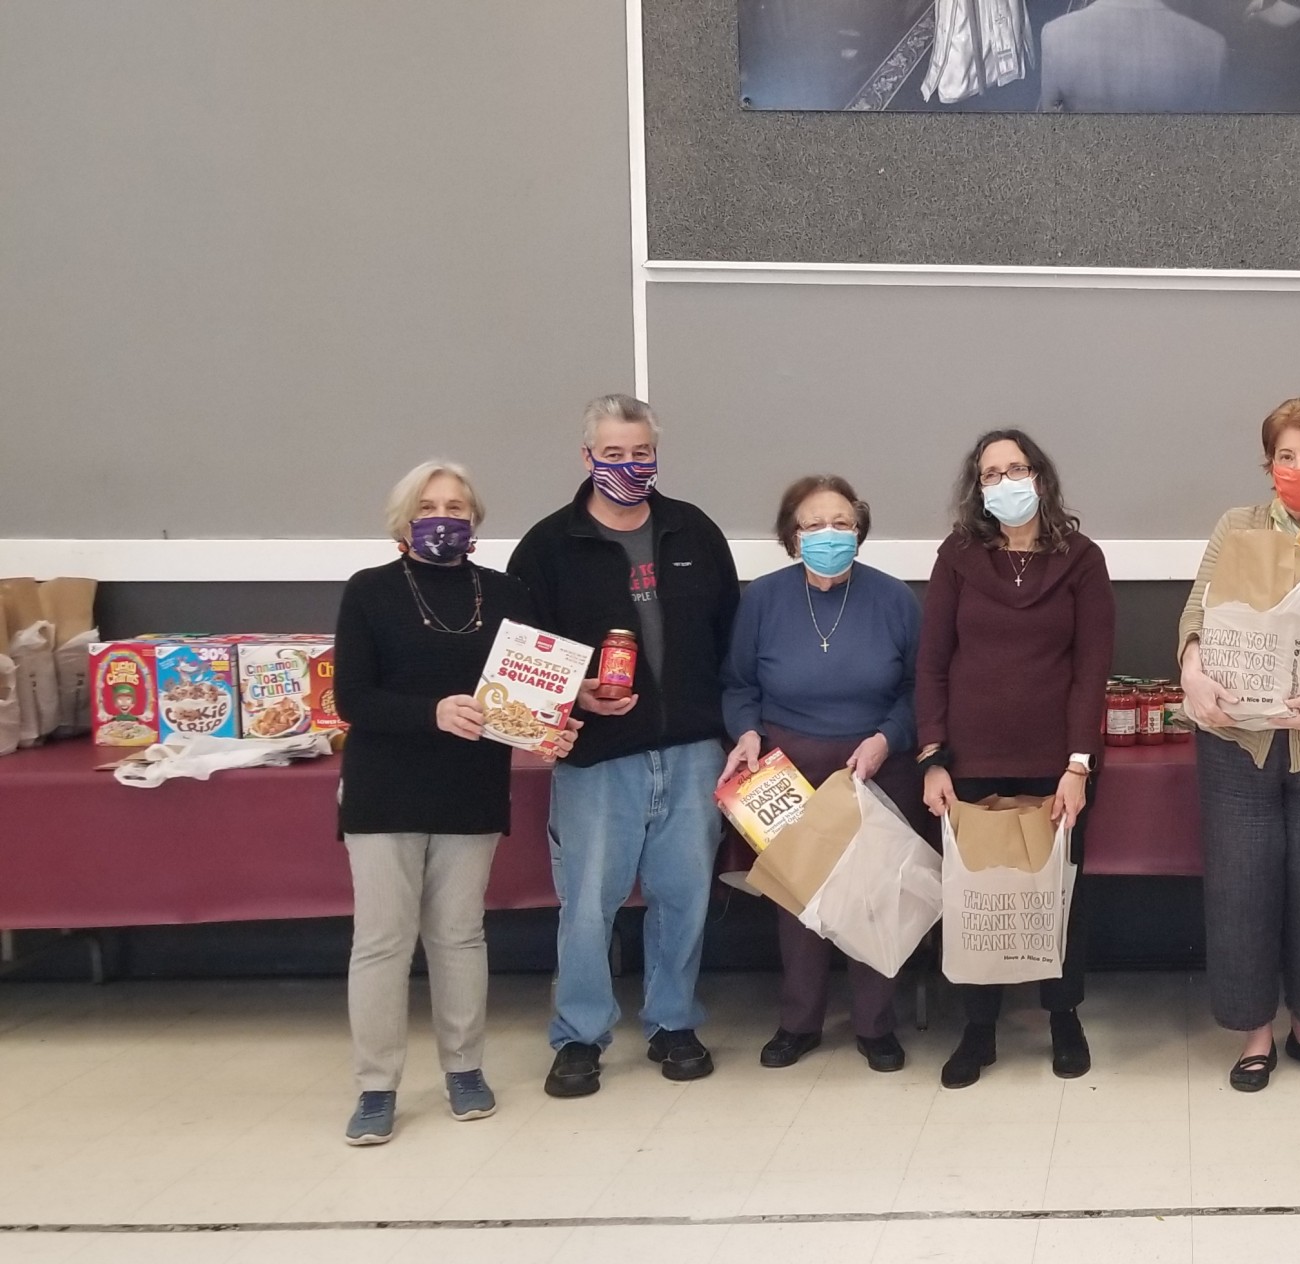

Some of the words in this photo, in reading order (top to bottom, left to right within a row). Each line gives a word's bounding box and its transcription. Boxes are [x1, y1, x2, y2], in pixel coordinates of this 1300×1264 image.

[1246, 632, 1278, 652] YOU
[199, 648, 229, 660] 30%
[505, 649, 571, 675] TOASTED
[1244, 651, 1276, 672] YOU
[246, 660, 298, 675] Cinnamon
[501, 658, 568, 685] CINNAMON
[497, 667, 565, 694] SQUARES
[1242, 673, 1274, 691] YOU
[740, 782, 766, 804] HONEY
[769, 770, 787, 784] NUT
[745, 777, 792, 813] TOASTED
[757, 788, 803, 826] OATS
[963, 889, 1016, 911] THANK
[1021, 891, 1055, 910] YOU
[962, 912, 1016, 931] THANK
[1020, 912, 1055, 931] YOU
[962, 932, 1016, 951] THANK
[1021, 933, 1055, 952] YOU
